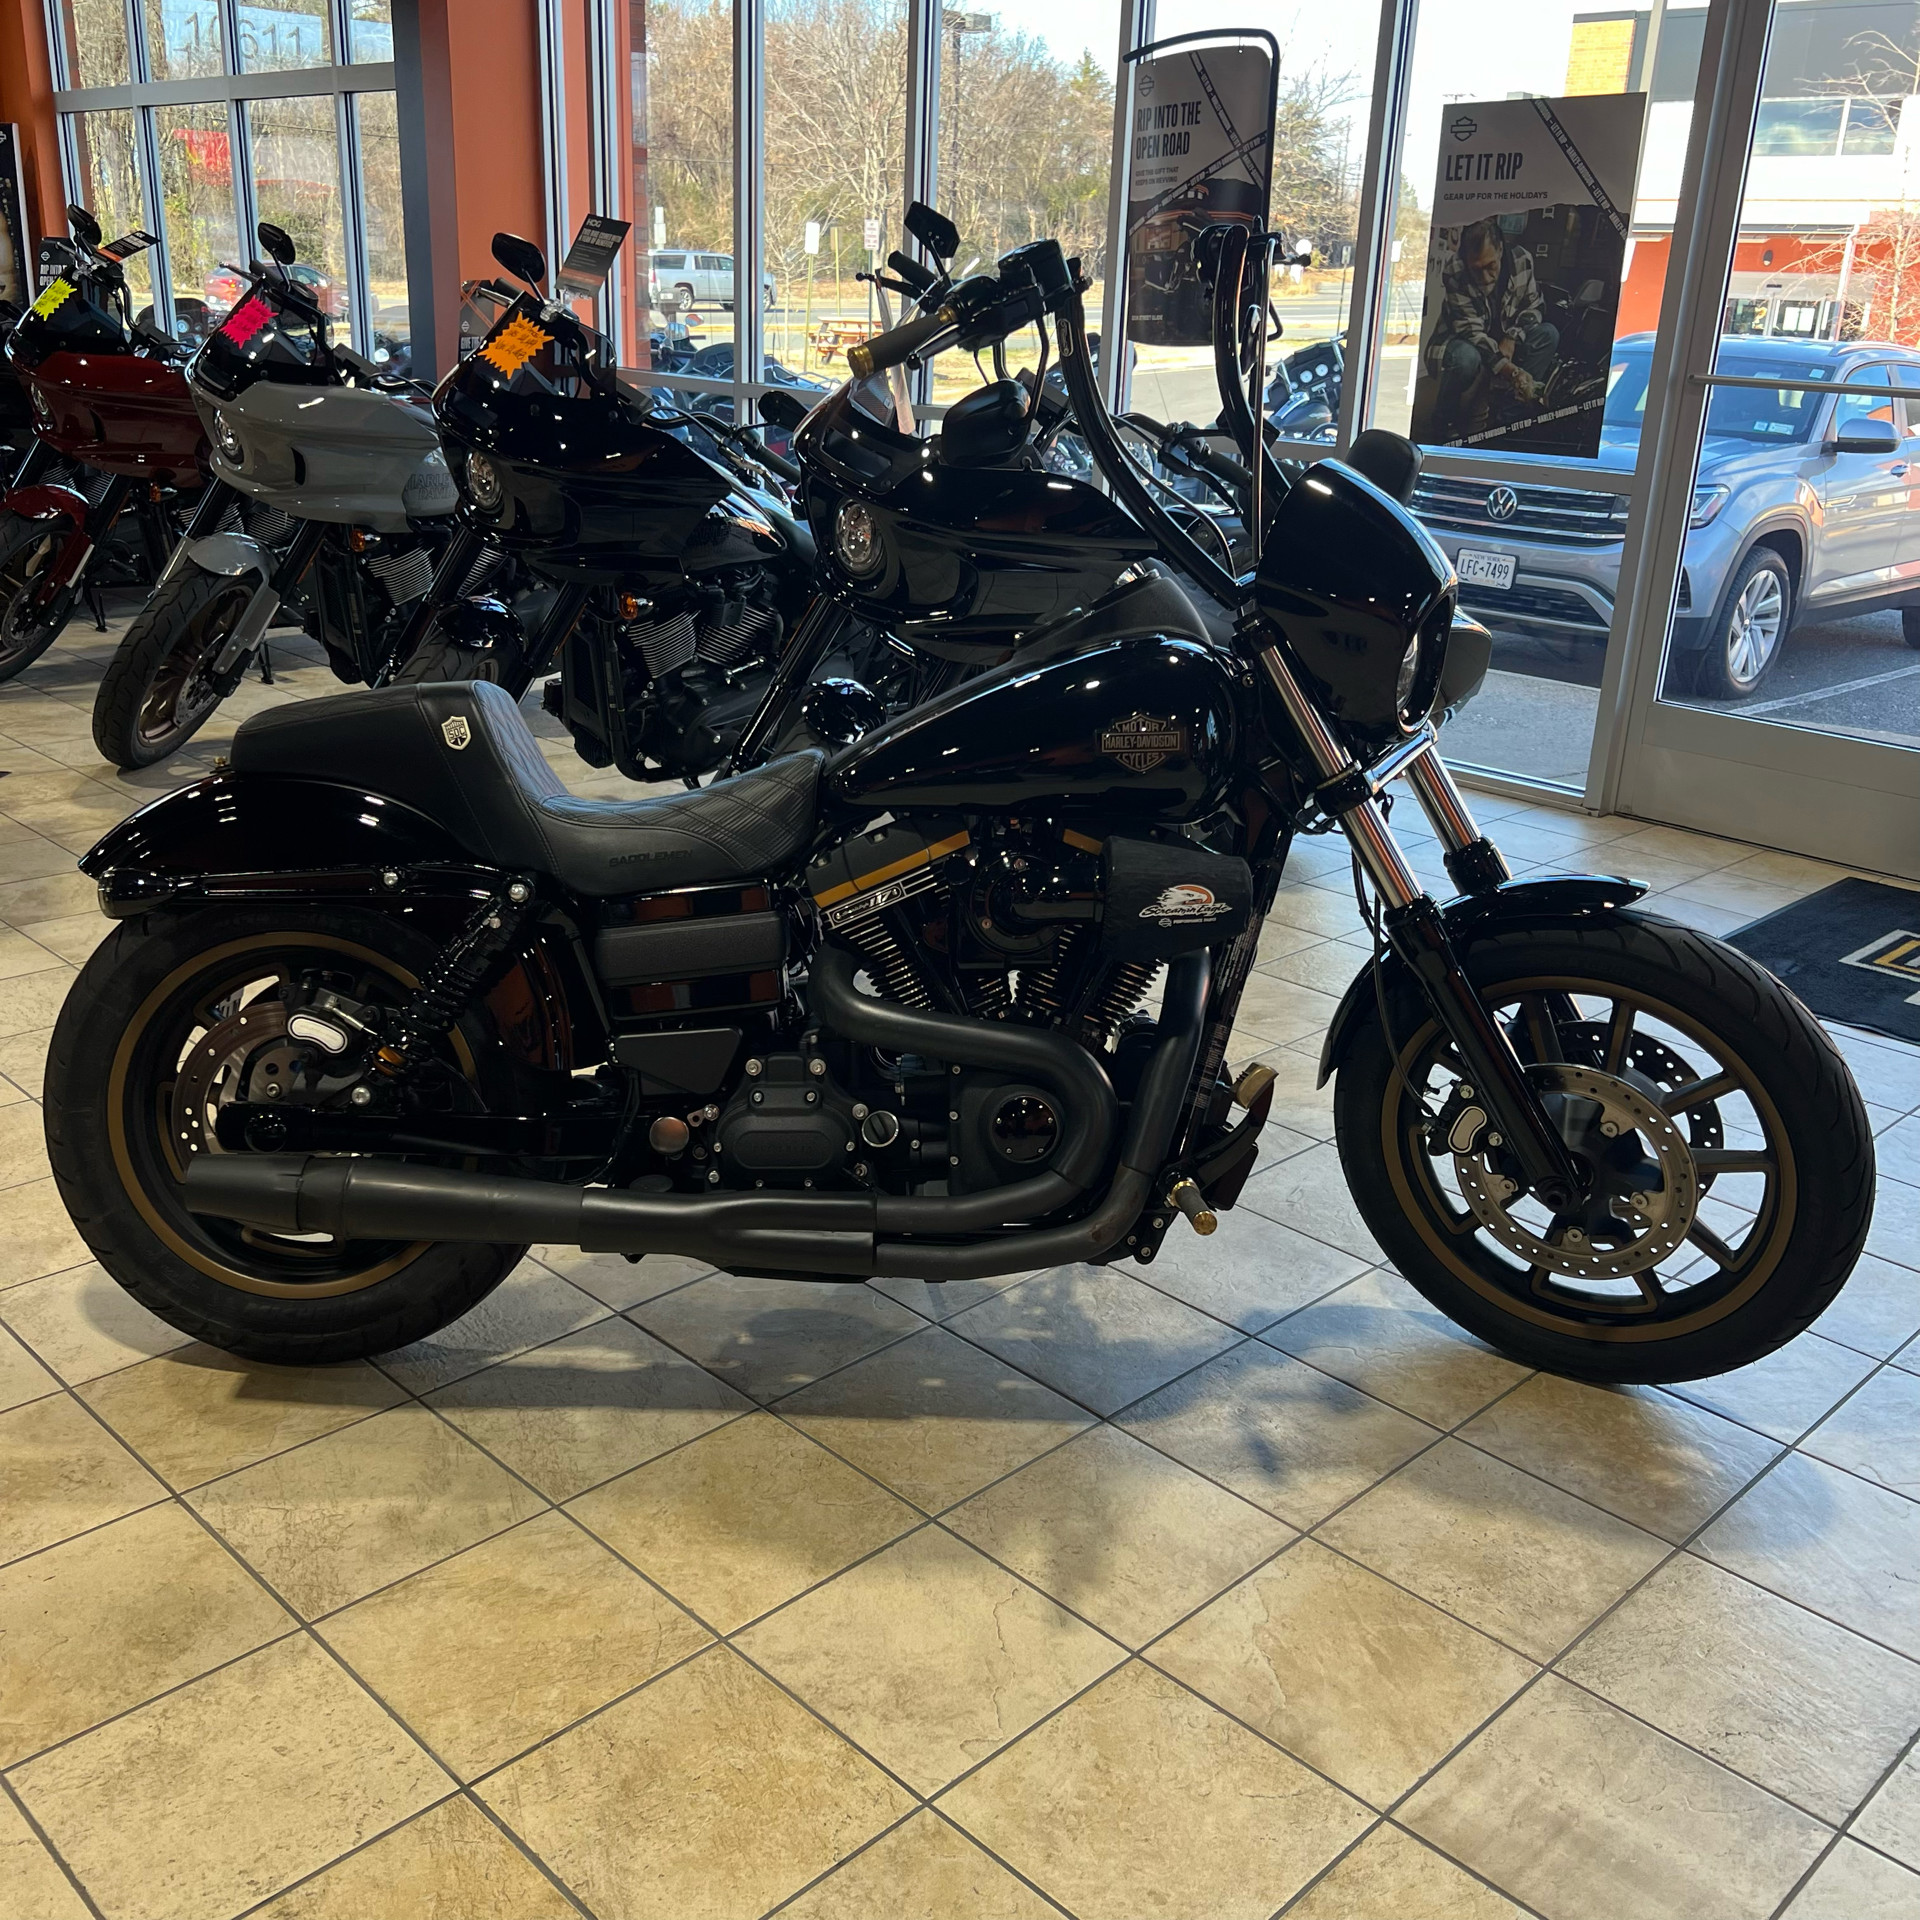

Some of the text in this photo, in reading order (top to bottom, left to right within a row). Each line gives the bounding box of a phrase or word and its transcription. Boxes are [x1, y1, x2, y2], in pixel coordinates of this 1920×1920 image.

[1137, 100, 1202, 132] RIP INTO THE
[1136, 131, 1191, 160] OPEN ROAD
[1445, 152, 1524, 182] LET IT RIP
[1444, 191, 1548, 201] GEAR UP FOR THE HOLIDAYS
[1536, 405, 1579, 423] HARLEY-DAVIDSON
[1583, 401, 1592, 410] LET
[1467, 426, 1507, 444] HARLEY-DAVIDSON
[1510, 422, 1520, 432] LET
[1485, 562, 1509, 580] 7499
[1122, 719, 1160, 732] MOTOR
[1105, 734, 1177, 749] HARLEY-DAVIDSON
[1122, 752, 1160, 769] CYCLES
[609, 849, 693, 867] SADDLEMEN
[868, 889, 892, 907] 117
[1196, 904, 1228, 916] Eagle
